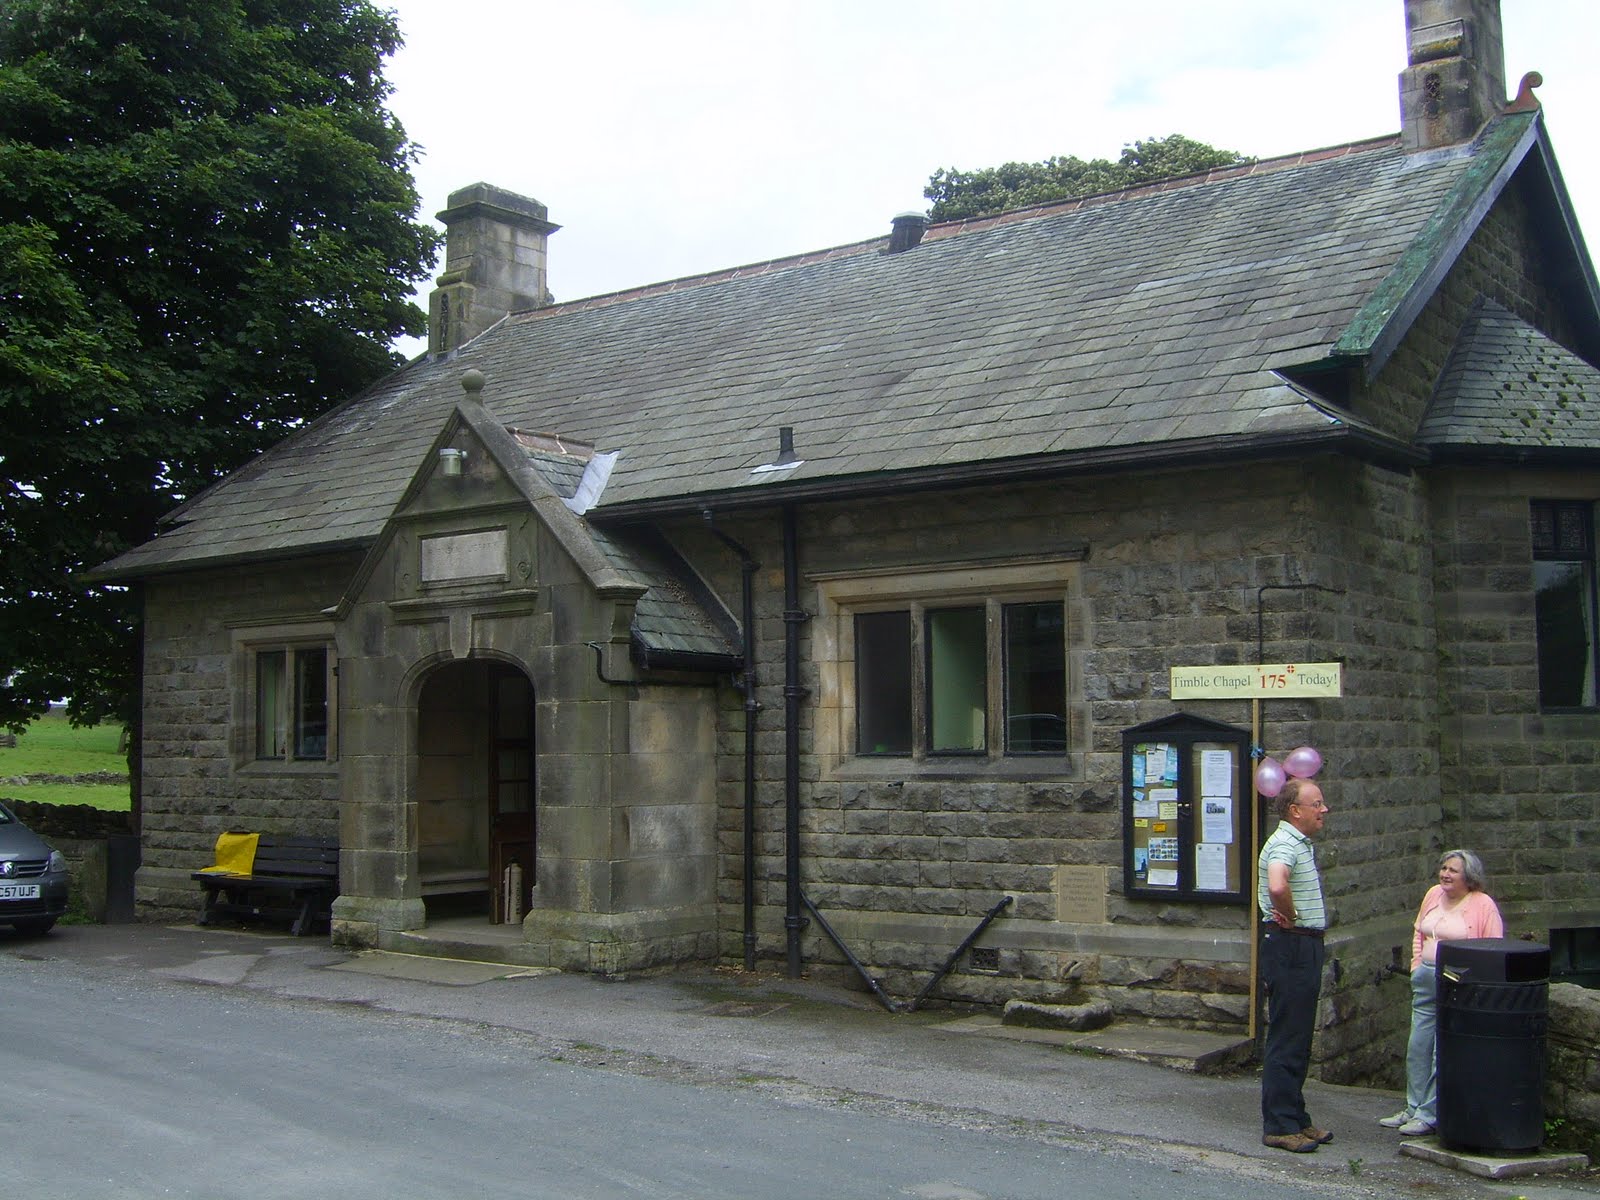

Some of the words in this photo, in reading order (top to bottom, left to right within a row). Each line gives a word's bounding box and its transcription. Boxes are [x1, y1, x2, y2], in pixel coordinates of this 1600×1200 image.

[1172, 676, 1210, 688] Timble
[1213, 675, 1250, 689] Chapel
[1260, 674, 1286, 689] 175
[1297, 673, 1338, 688] Today!
[19, 886, 36, 896] UJF
